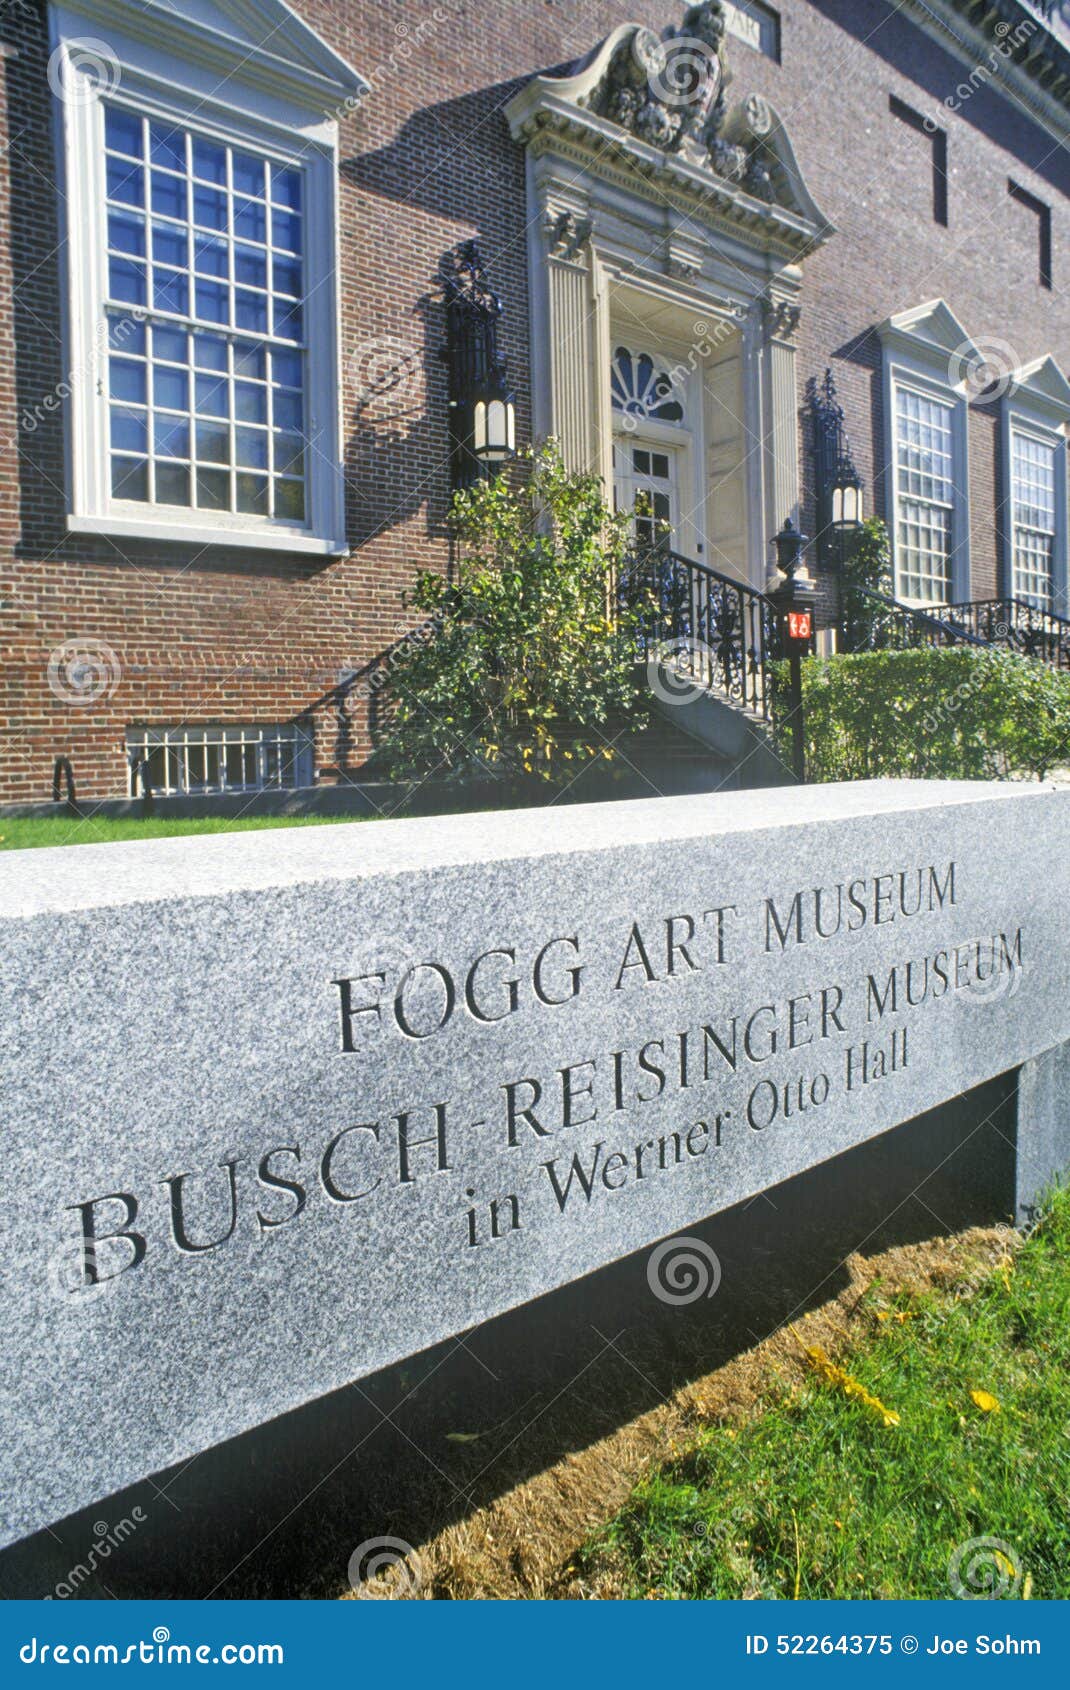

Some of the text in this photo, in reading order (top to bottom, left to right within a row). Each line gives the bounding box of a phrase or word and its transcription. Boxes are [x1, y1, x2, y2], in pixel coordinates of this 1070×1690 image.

[330, 861, 957, 1054] FOGG ART MUSEUM
[866, 926, 1025, 1025] MUSEUM
[465, 1026, 909, 1248] in Werner Otto Hall
